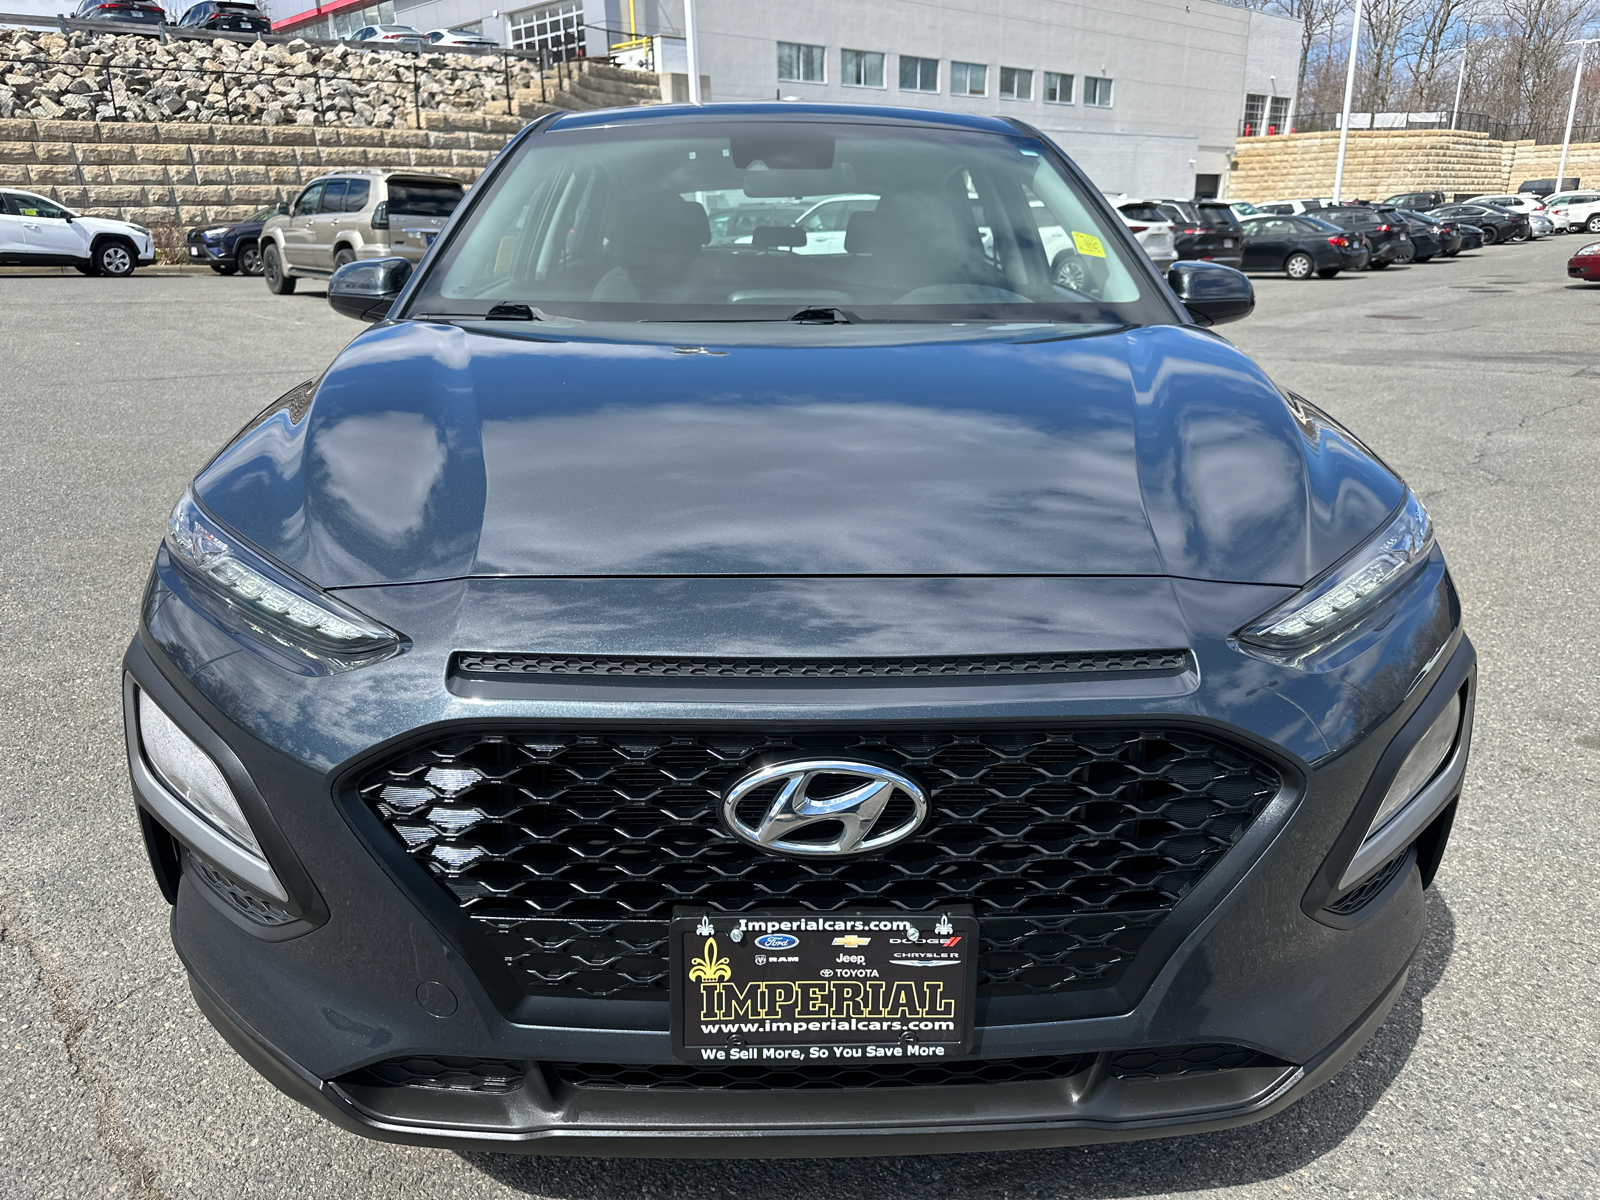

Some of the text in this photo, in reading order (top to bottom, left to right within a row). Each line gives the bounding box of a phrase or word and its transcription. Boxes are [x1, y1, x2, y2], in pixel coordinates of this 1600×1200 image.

[739, 918, 911, 933] Imperialcars.com
[764, 936, 790, 947] Ford
[835, 953, 866, 966] Jeep
[835, 969, 880, 978] TOYOTA
[700, 981, 955, 1020] IMPERIAL
[700, 1018, 955, 1034] www.imperialcars.com
[700, 1044, 945, 1061] We Sell More, So You Save More
